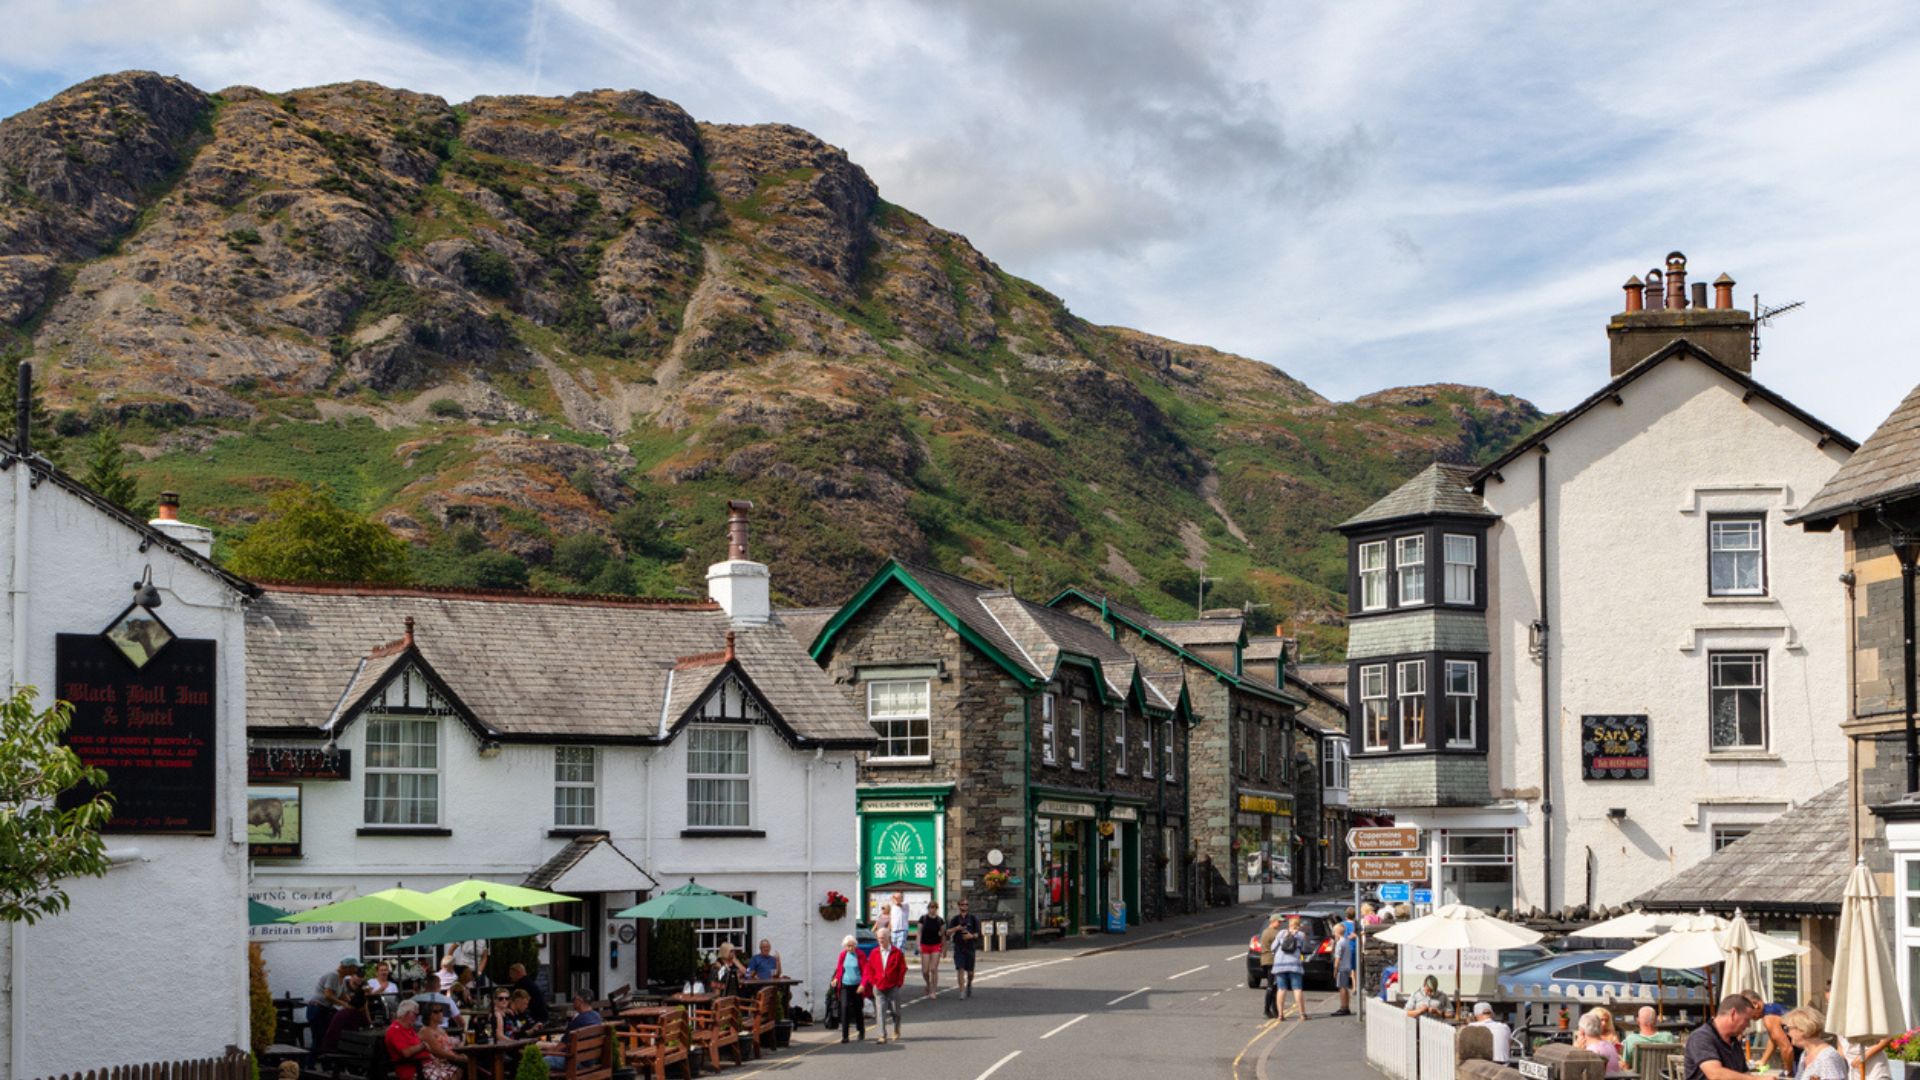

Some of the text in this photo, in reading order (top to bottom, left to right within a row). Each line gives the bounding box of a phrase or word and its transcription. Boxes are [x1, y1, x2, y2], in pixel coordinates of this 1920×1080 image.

[64, 683, 209, 705] Black Bull Inn
[103, 705, 174, 728] & Hotel
[1593, 726, 1642, 742] Sara's
[1358, 831, 1402, 839] Coppermines
[314, 890, 333, 900] Ltd
[261, 926, 301, 936] Britain
[306, 925, 334, 934] 1998
